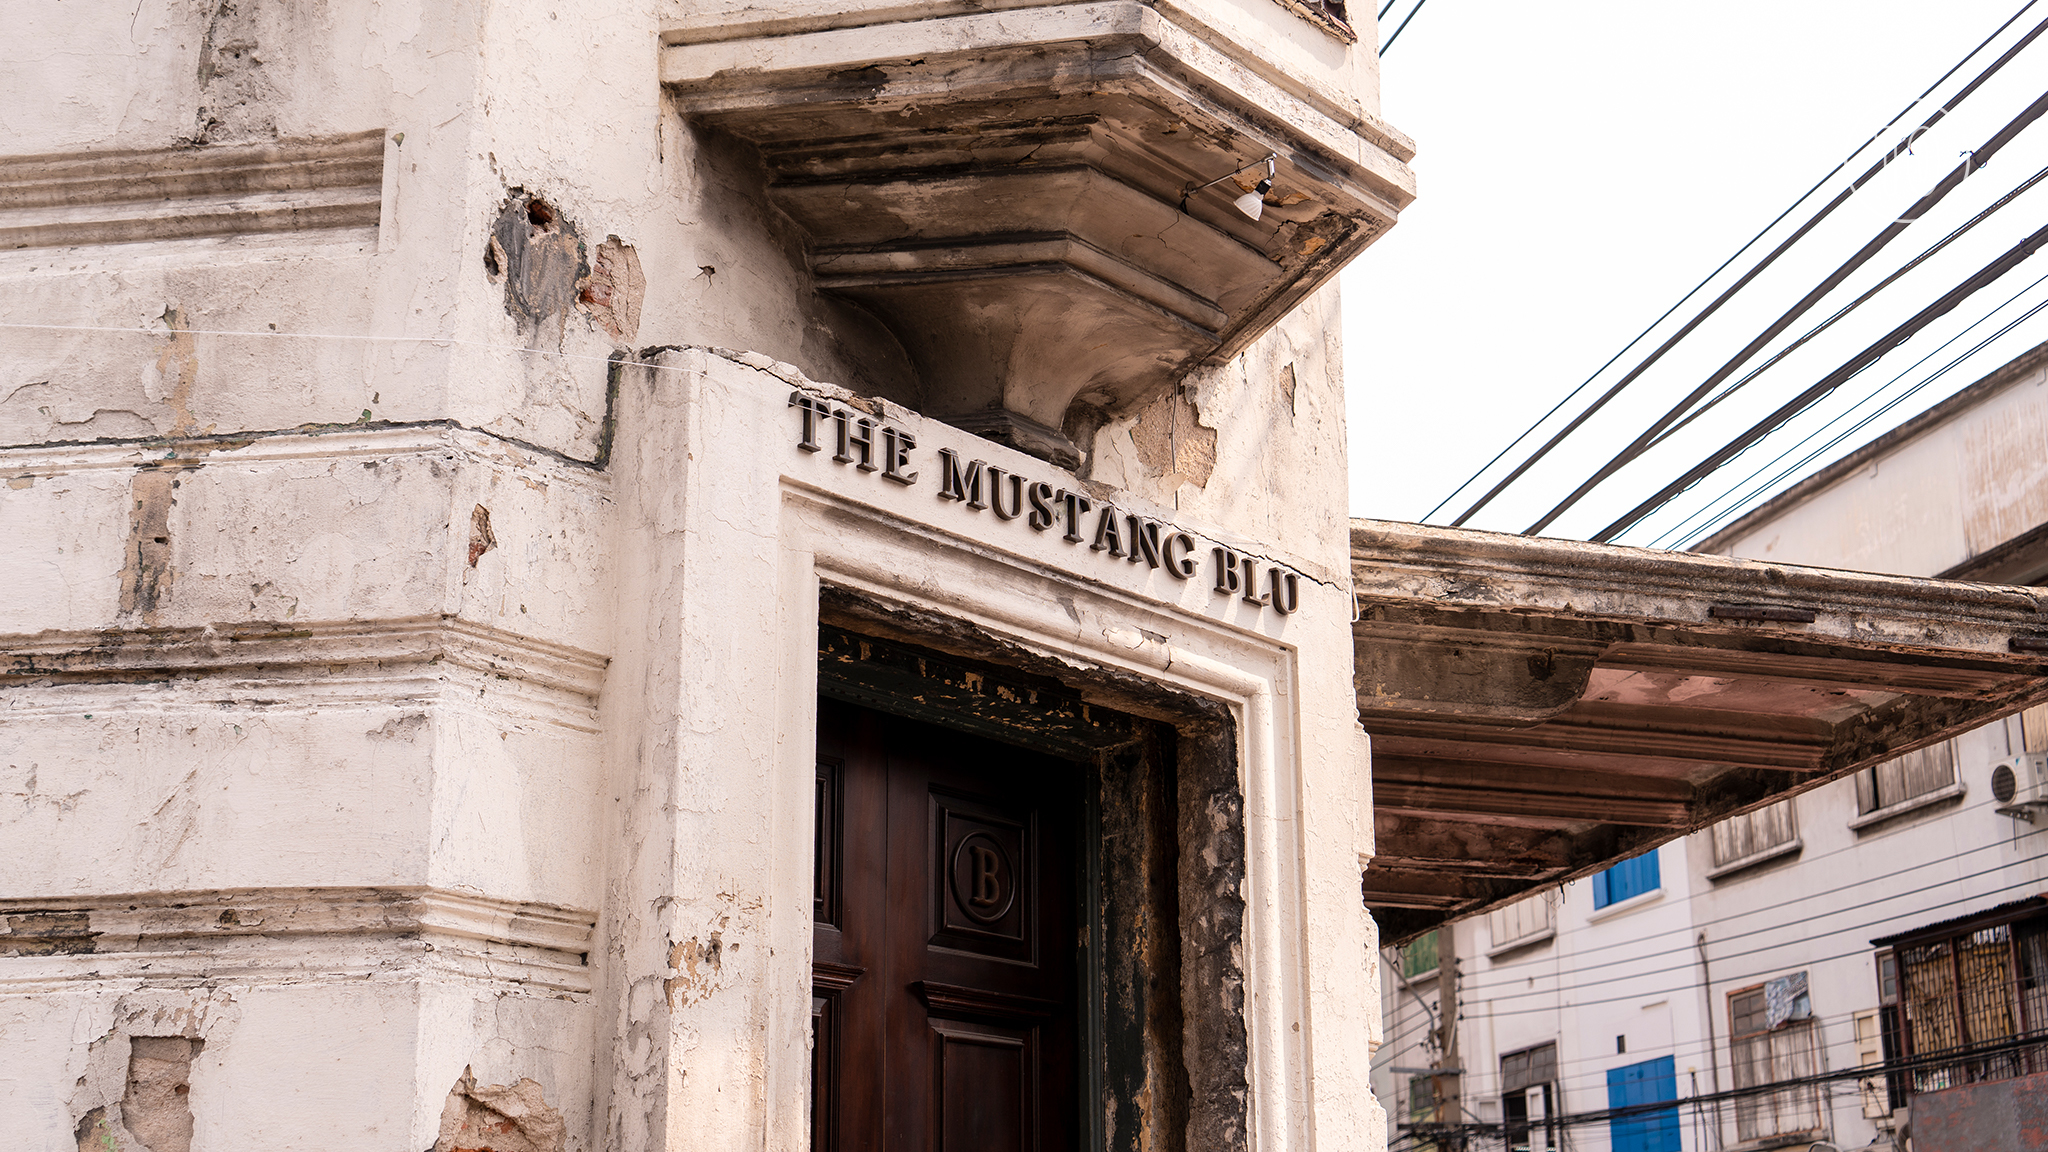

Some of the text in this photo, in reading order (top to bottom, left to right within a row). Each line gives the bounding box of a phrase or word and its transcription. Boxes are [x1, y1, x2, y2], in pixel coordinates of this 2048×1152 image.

[788, 392, 1301, 615] THE MUSTANG BLU
[969, 846, 1000, 906] B
